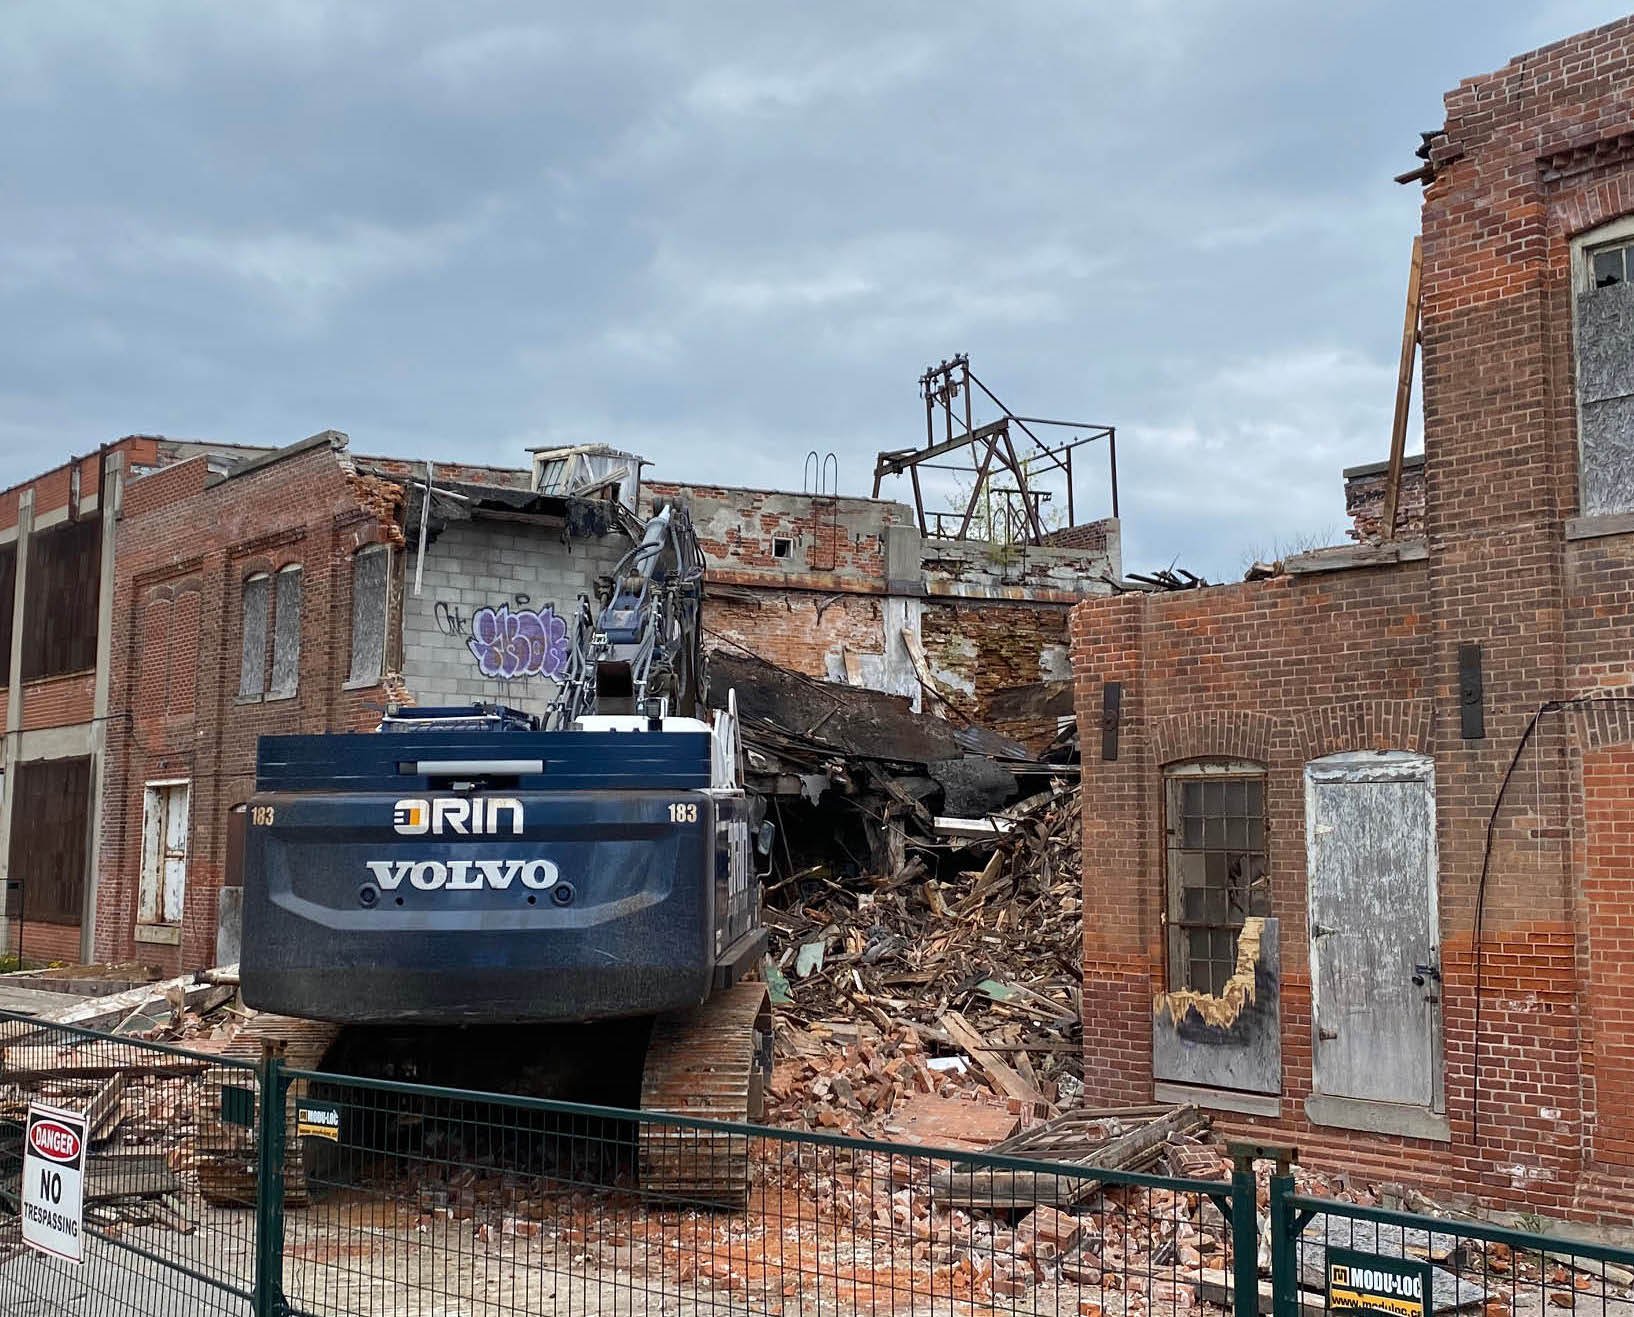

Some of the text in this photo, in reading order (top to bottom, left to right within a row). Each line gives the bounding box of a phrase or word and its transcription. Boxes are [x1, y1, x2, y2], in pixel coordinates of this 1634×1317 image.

[251, 806, 275, 826] 183
[668, 803, 697, 823] 183
[366, 859, 559, 890] VOLVO
[35, 1126, 74, 1156] DANGER
[40, 1168, 62, 1205] NO
[24, 1202, 78, 1238] TRESPASSING
